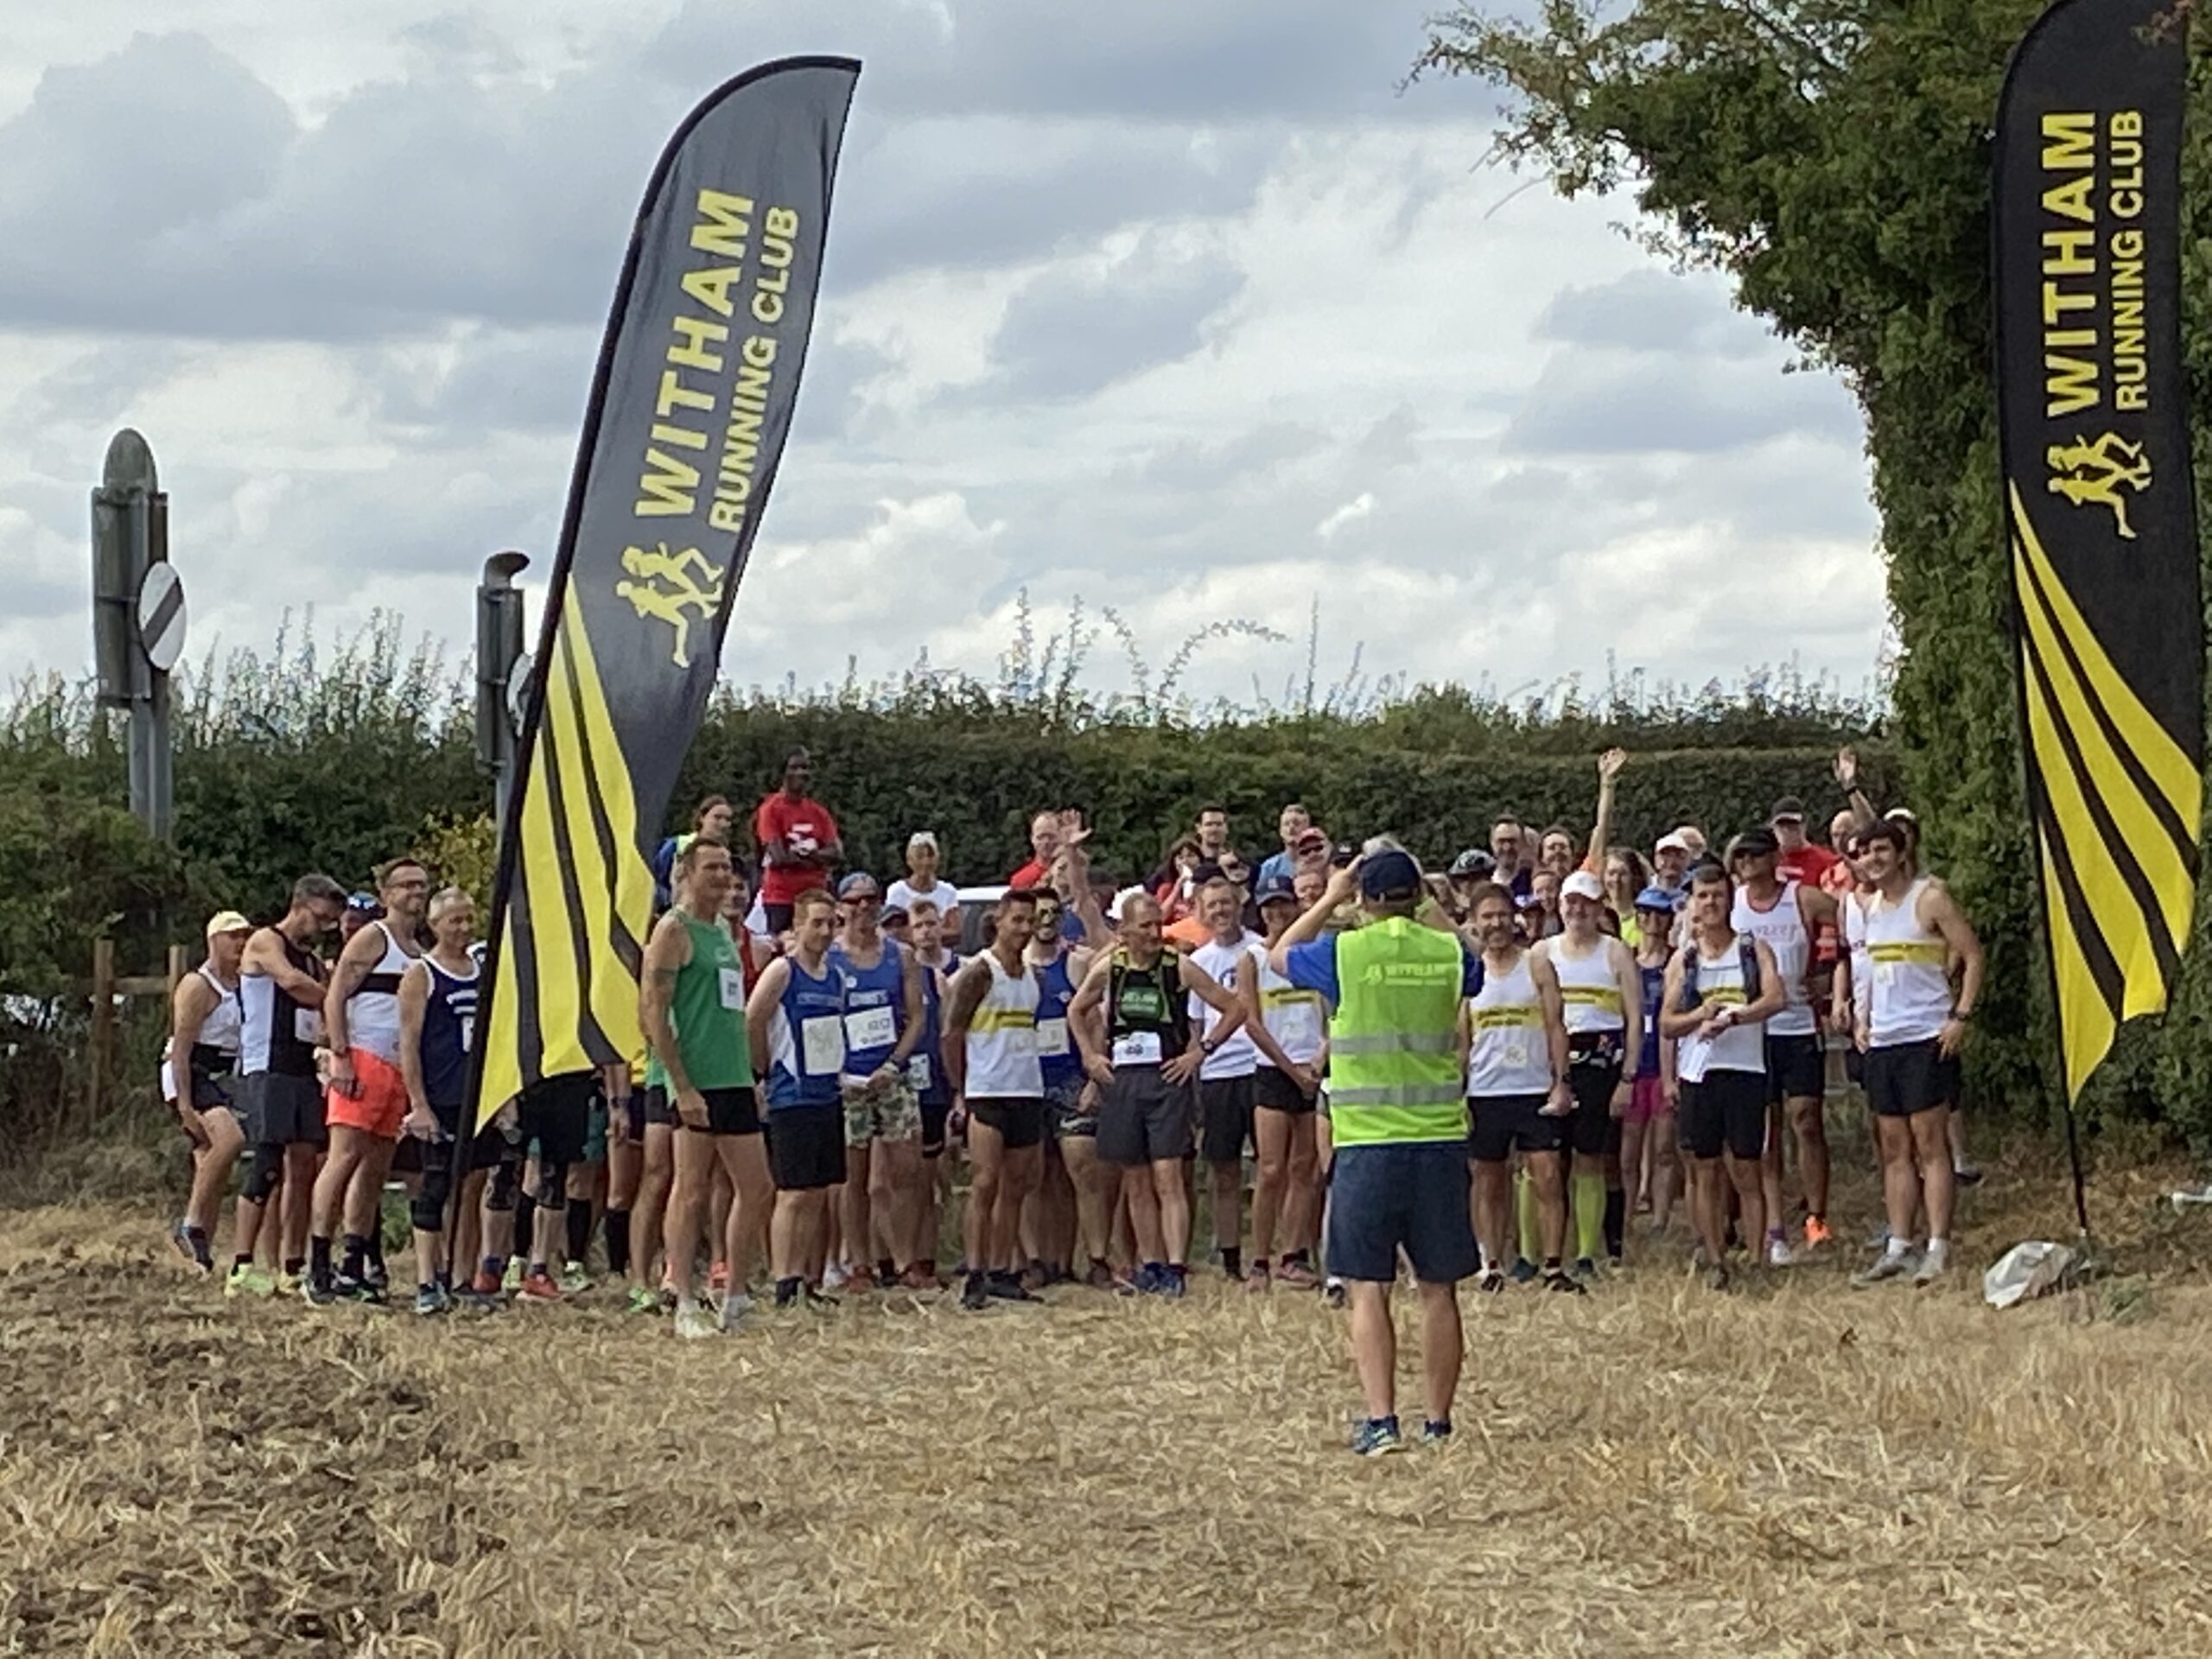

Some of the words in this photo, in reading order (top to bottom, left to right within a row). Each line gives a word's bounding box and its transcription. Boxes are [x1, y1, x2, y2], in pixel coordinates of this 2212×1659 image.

[2041, 111, 2101, 417] WITHAM
[2108, 109, 2144, 218] CLUB
[634, 188, 755, 517] WITHAM
[709, 337, 777, 531] RUNNING
[751, 207, 799, 325] CLUB
[2110, 229, 2148, 411] RUNNING
